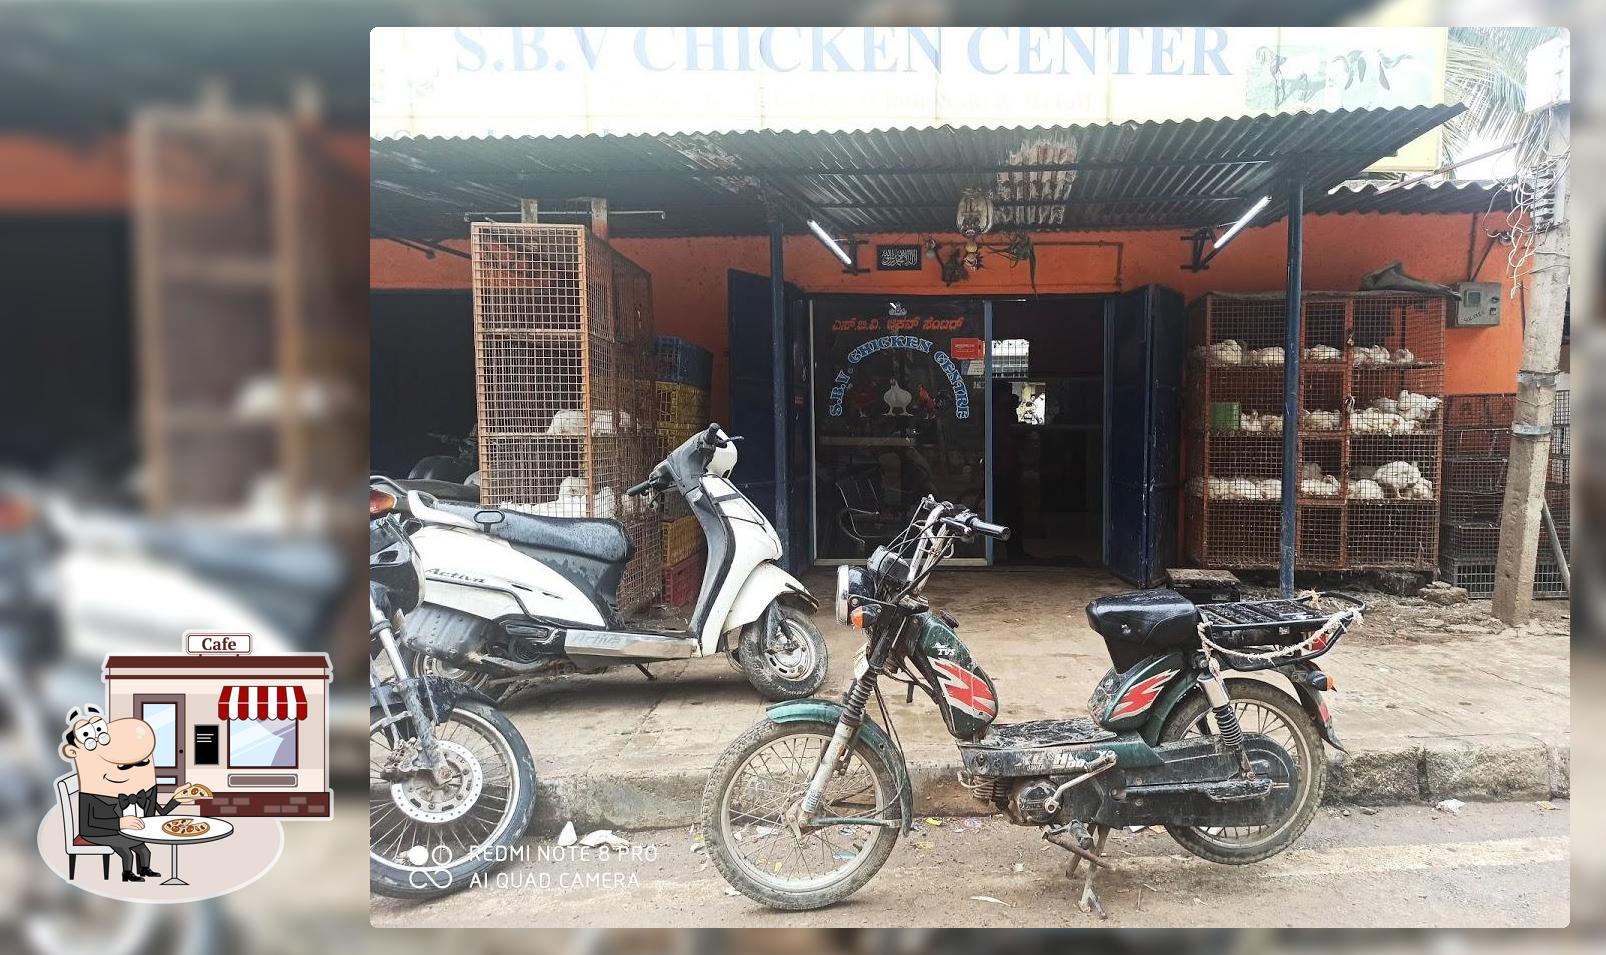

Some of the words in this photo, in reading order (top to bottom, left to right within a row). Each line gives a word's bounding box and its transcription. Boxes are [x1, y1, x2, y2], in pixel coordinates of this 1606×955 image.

[633, 27, 943, 74] CHICKEN
[966, 27, 1233, 75] CENTER
[847, 335, 934, 364] CHICKEN
[933, 350, 970, 420] CENTRE
[937, 648, 956, 656] TVS
